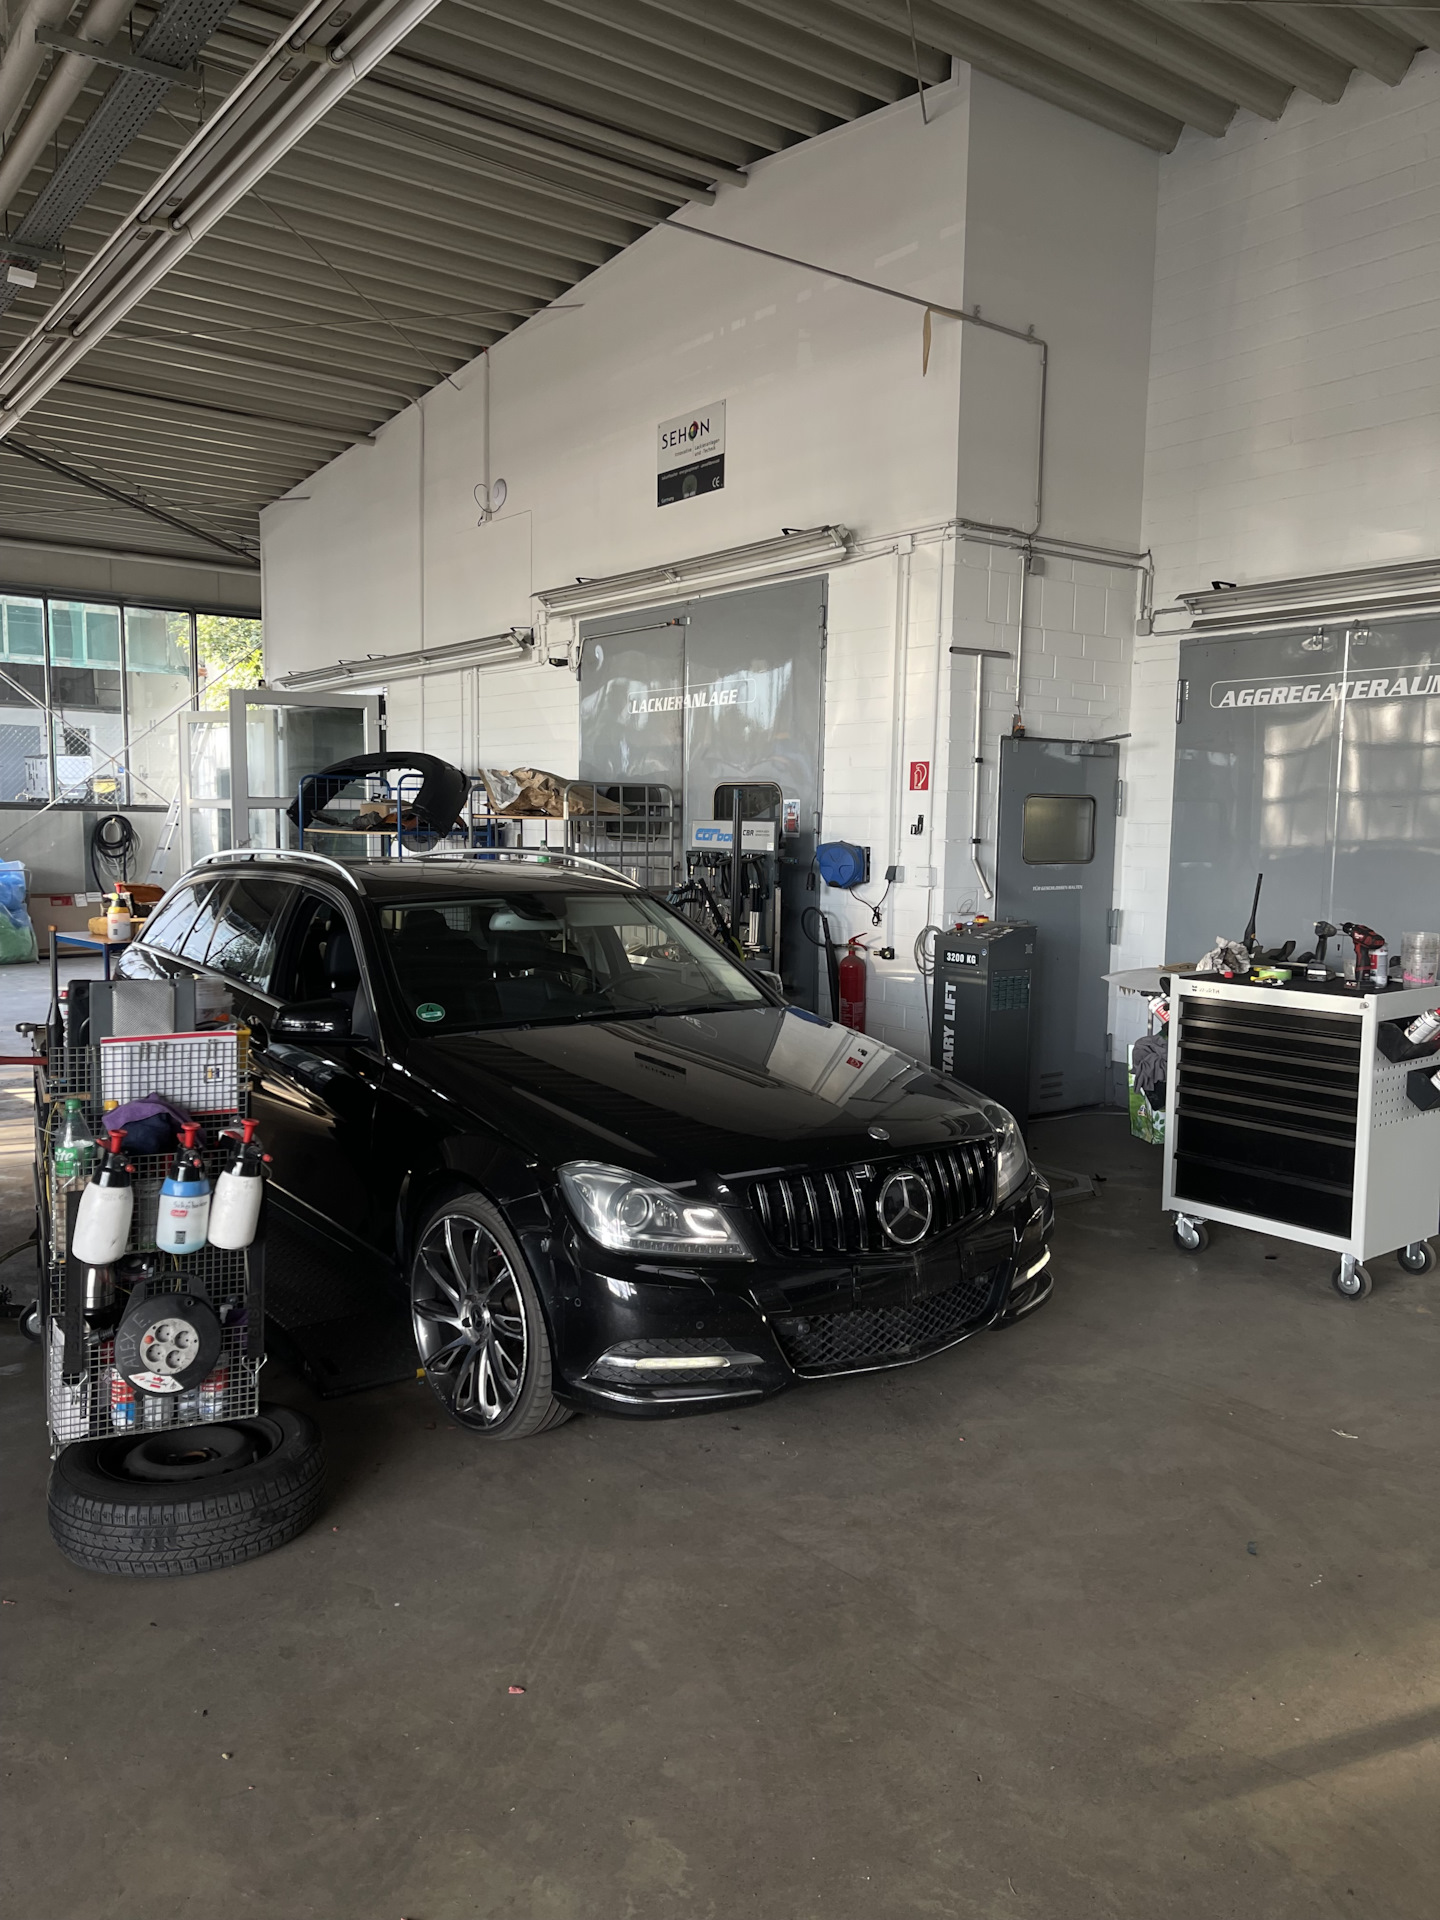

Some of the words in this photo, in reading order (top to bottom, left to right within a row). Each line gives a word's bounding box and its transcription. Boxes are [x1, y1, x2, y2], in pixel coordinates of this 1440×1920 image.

[661, 418, 710, 450] SEHON
[631, 689, 738, 714] LACKIERANLAGE
[946, 952, 965, 963] 3200
[966, 954, 976, 964] KG
[944, 981, 957, 1022] LIFT
[942, 1025, 955, 1074] TARY
[122, 1331, 140, 1368] ALEX
